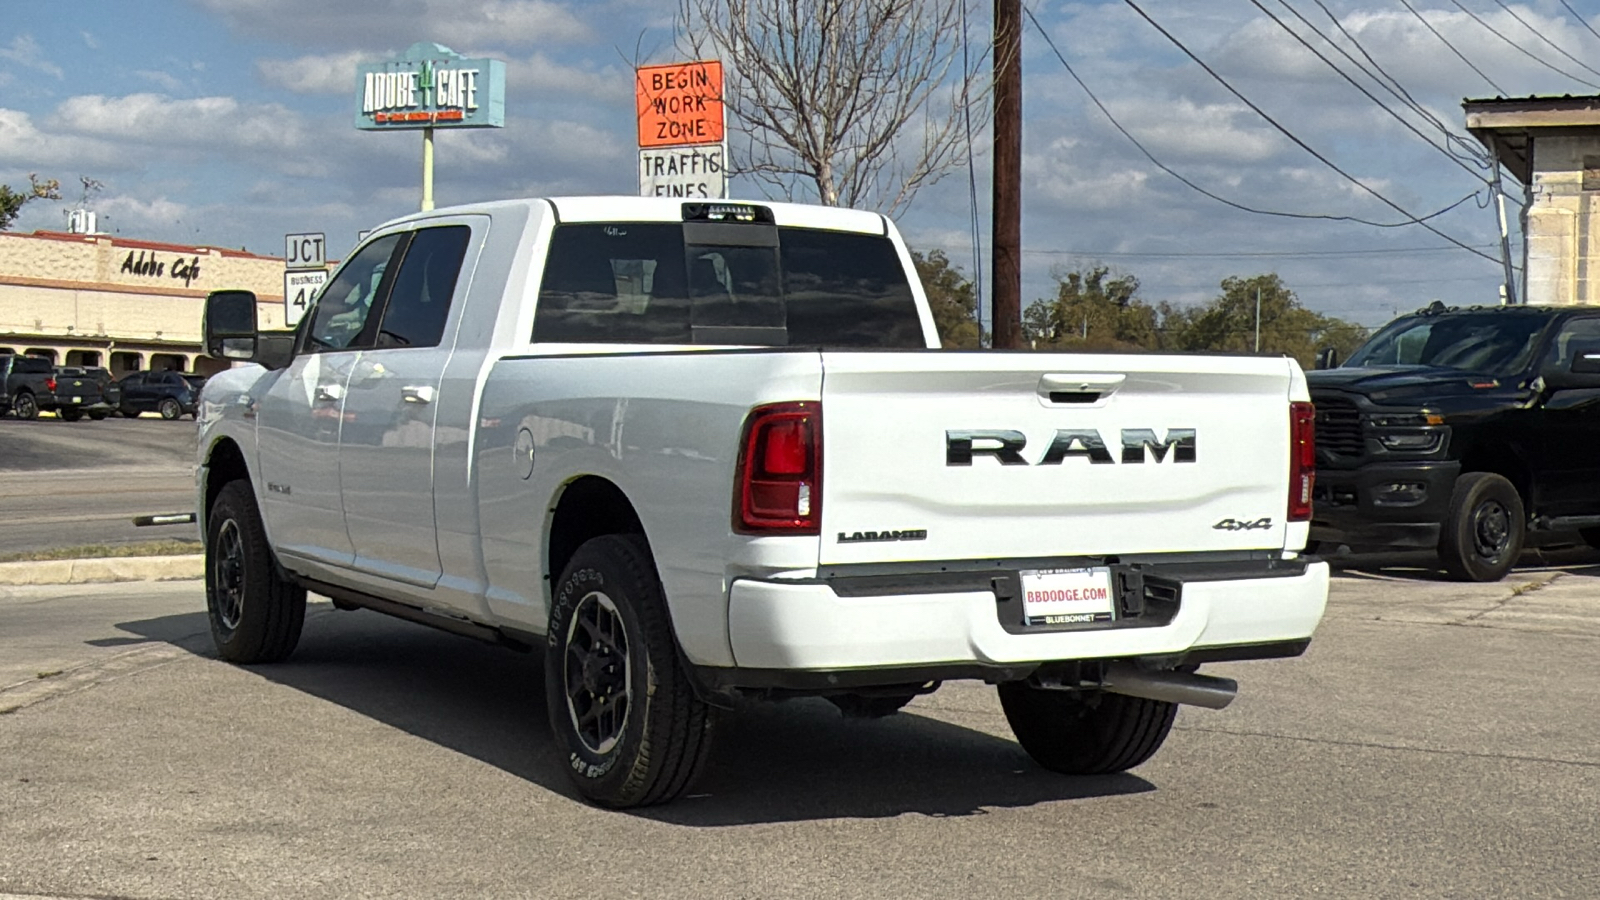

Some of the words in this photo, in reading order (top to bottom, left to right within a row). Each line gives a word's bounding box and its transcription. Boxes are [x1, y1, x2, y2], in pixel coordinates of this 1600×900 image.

[652, 68, 706, 90] BEGIN
[363, 71, 419, 112] ADOBE
[437, 69, 479, 109] CAFE
[654, 95, 706, 114] WORK
[656, 119, 706, 139] ZONE
[643, 152, 720, 176] TRAFFIC
[655, 183, 707, 197] FINES
[288, 239, 322, 262] JCT
[121, 250, 165, 277] Adobe
[290, 275, 323, 286] BUSINESS
[945, 428, 1196, 466] RAM
[1027, 588, 1107, 603] BBDODGE.COM
[1045, 614, 1095, 624] BLUEBONNET
